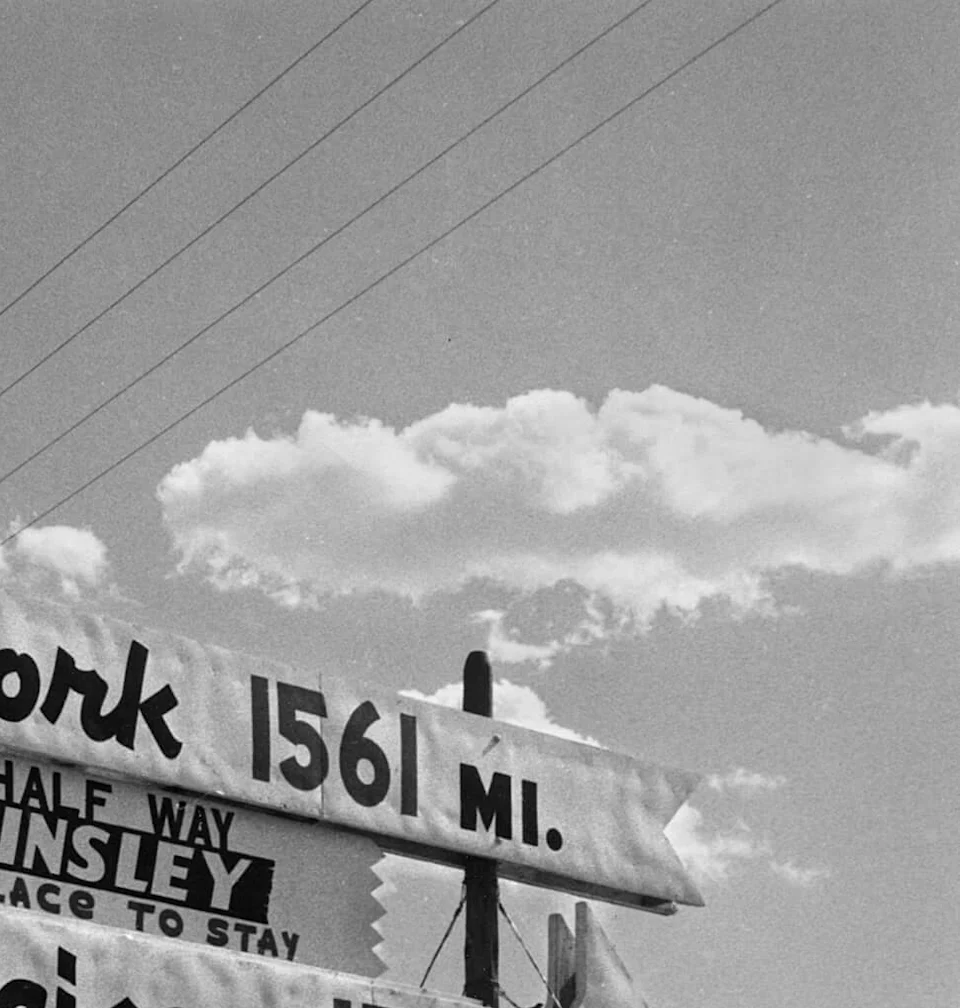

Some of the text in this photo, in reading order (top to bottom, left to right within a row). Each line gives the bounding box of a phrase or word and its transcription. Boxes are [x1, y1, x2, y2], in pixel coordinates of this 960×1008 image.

[251, 674, 418, 817] 1561
[460, 763, 563, 851] MI.
[148, 793, 235, 851] WAY
[127, 900, 184, 938] TO
[206, 917, 301, 962] STAY
